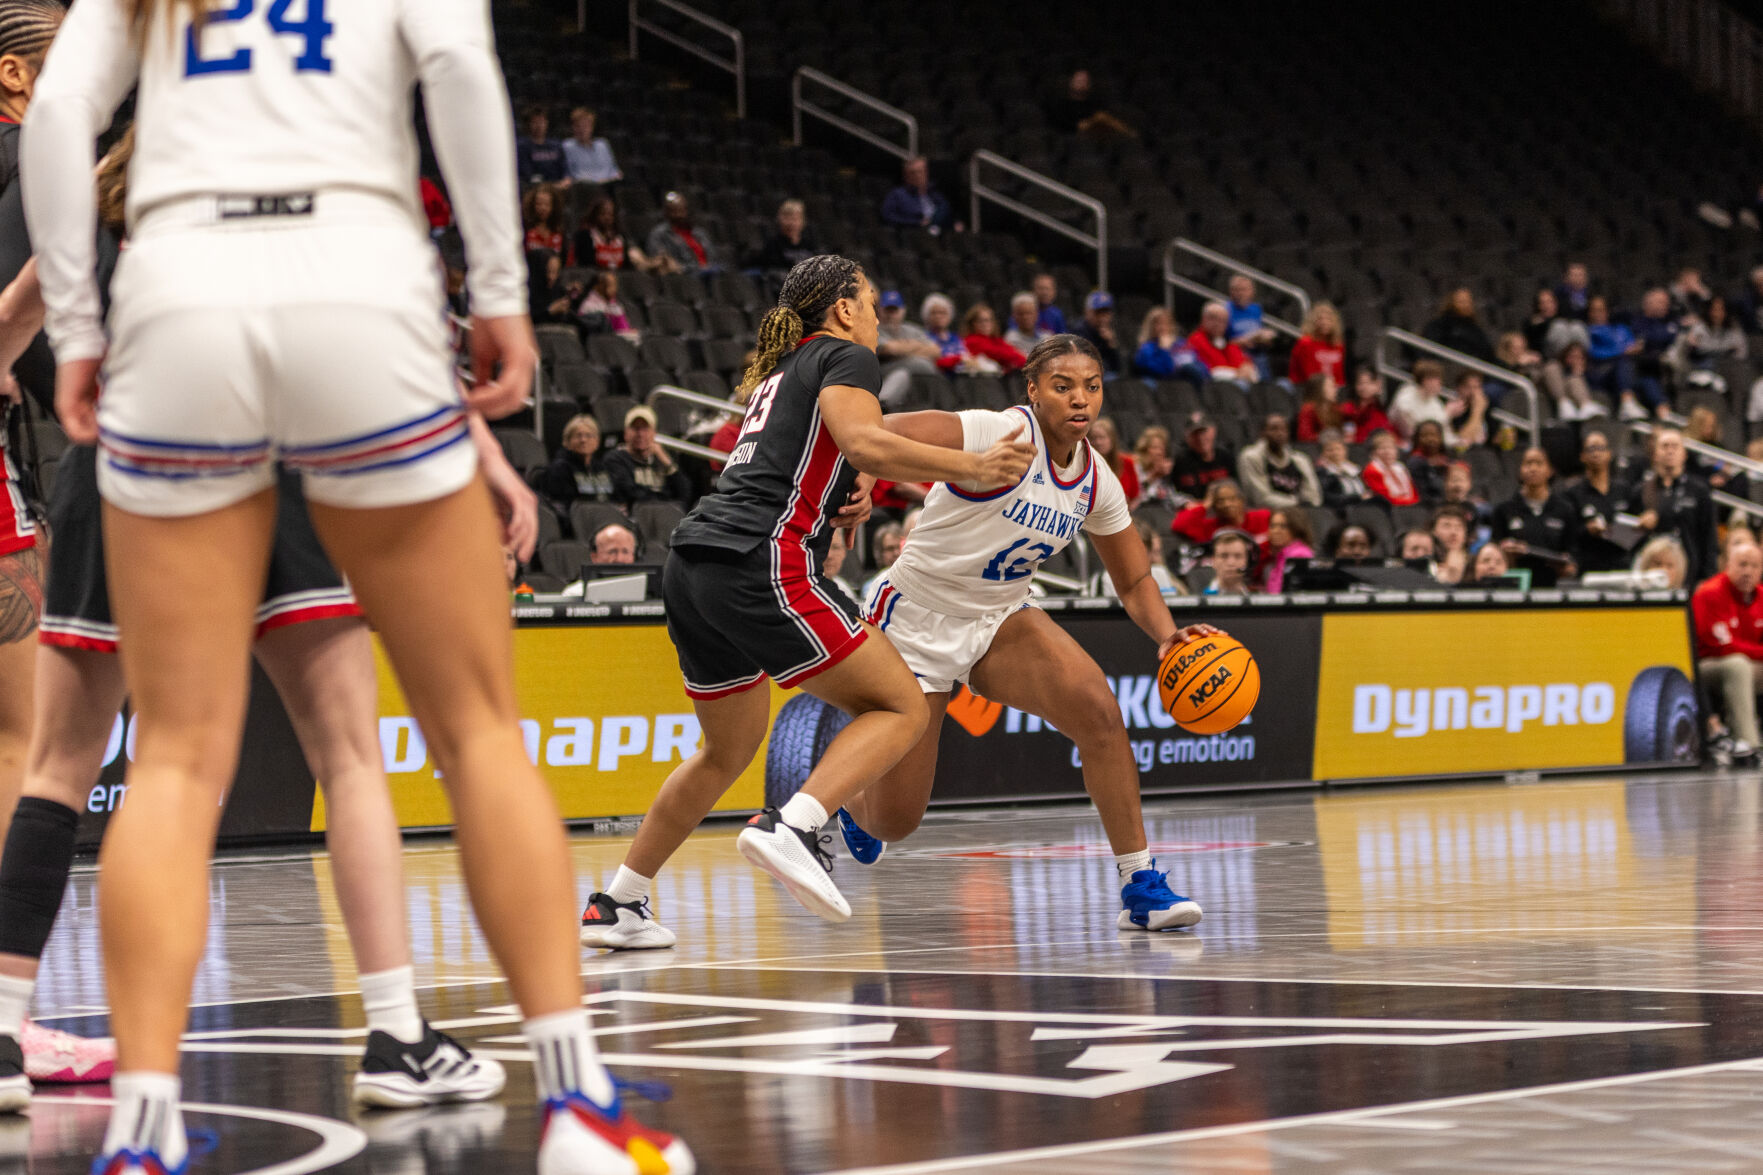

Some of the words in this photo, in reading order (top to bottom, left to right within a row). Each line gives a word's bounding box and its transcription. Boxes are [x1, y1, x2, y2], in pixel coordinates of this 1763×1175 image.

[184, 0, 334, 78] 24
[737, 371, 784, 442] 23
[981, 537, 1054, 581] 12
[1163, 642, 1217, 690] Wilson
[1188, 665, 1232, 708] NCAA
[1159, 732, 1255, 765] emotion
